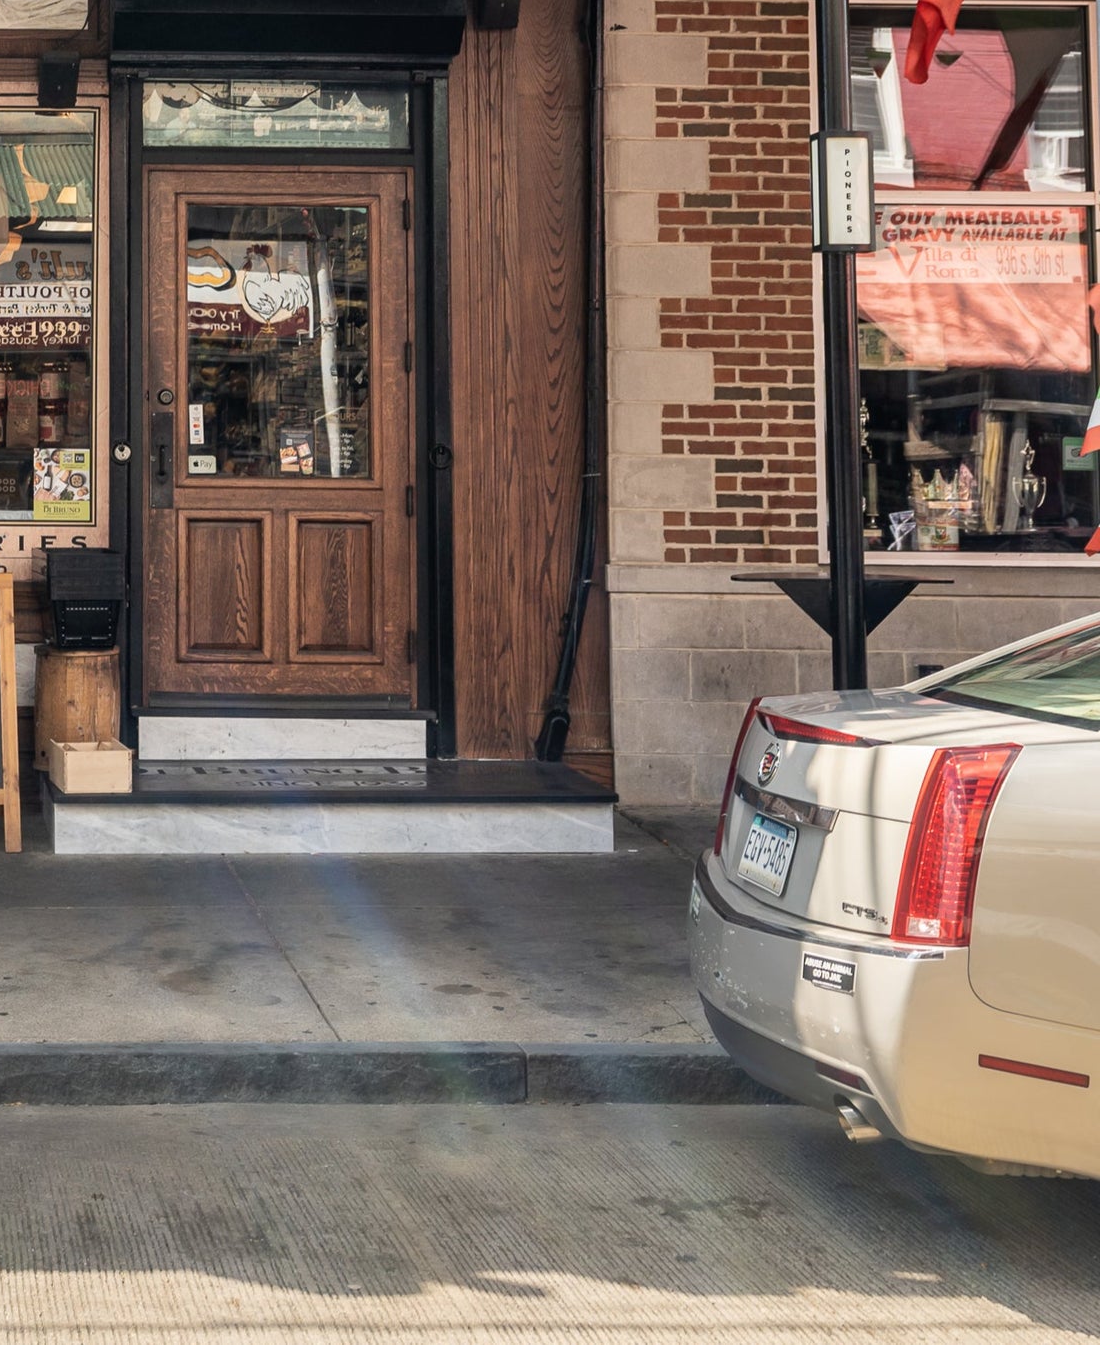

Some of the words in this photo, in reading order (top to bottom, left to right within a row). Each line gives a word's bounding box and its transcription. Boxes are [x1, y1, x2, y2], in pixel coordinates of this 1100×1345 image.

[844, 149, 852, 233] PIONEERS
[890, 211, 935, 225] OUT
[945, 210, 1062, 226] MEATBALLS
[882, 228, 955, 243] GRAVY
[960, 228, 1044, 242] AVAILABLE
[1048, 228, 1068, 241] AT
[200, 460, 212, 469] Pay
